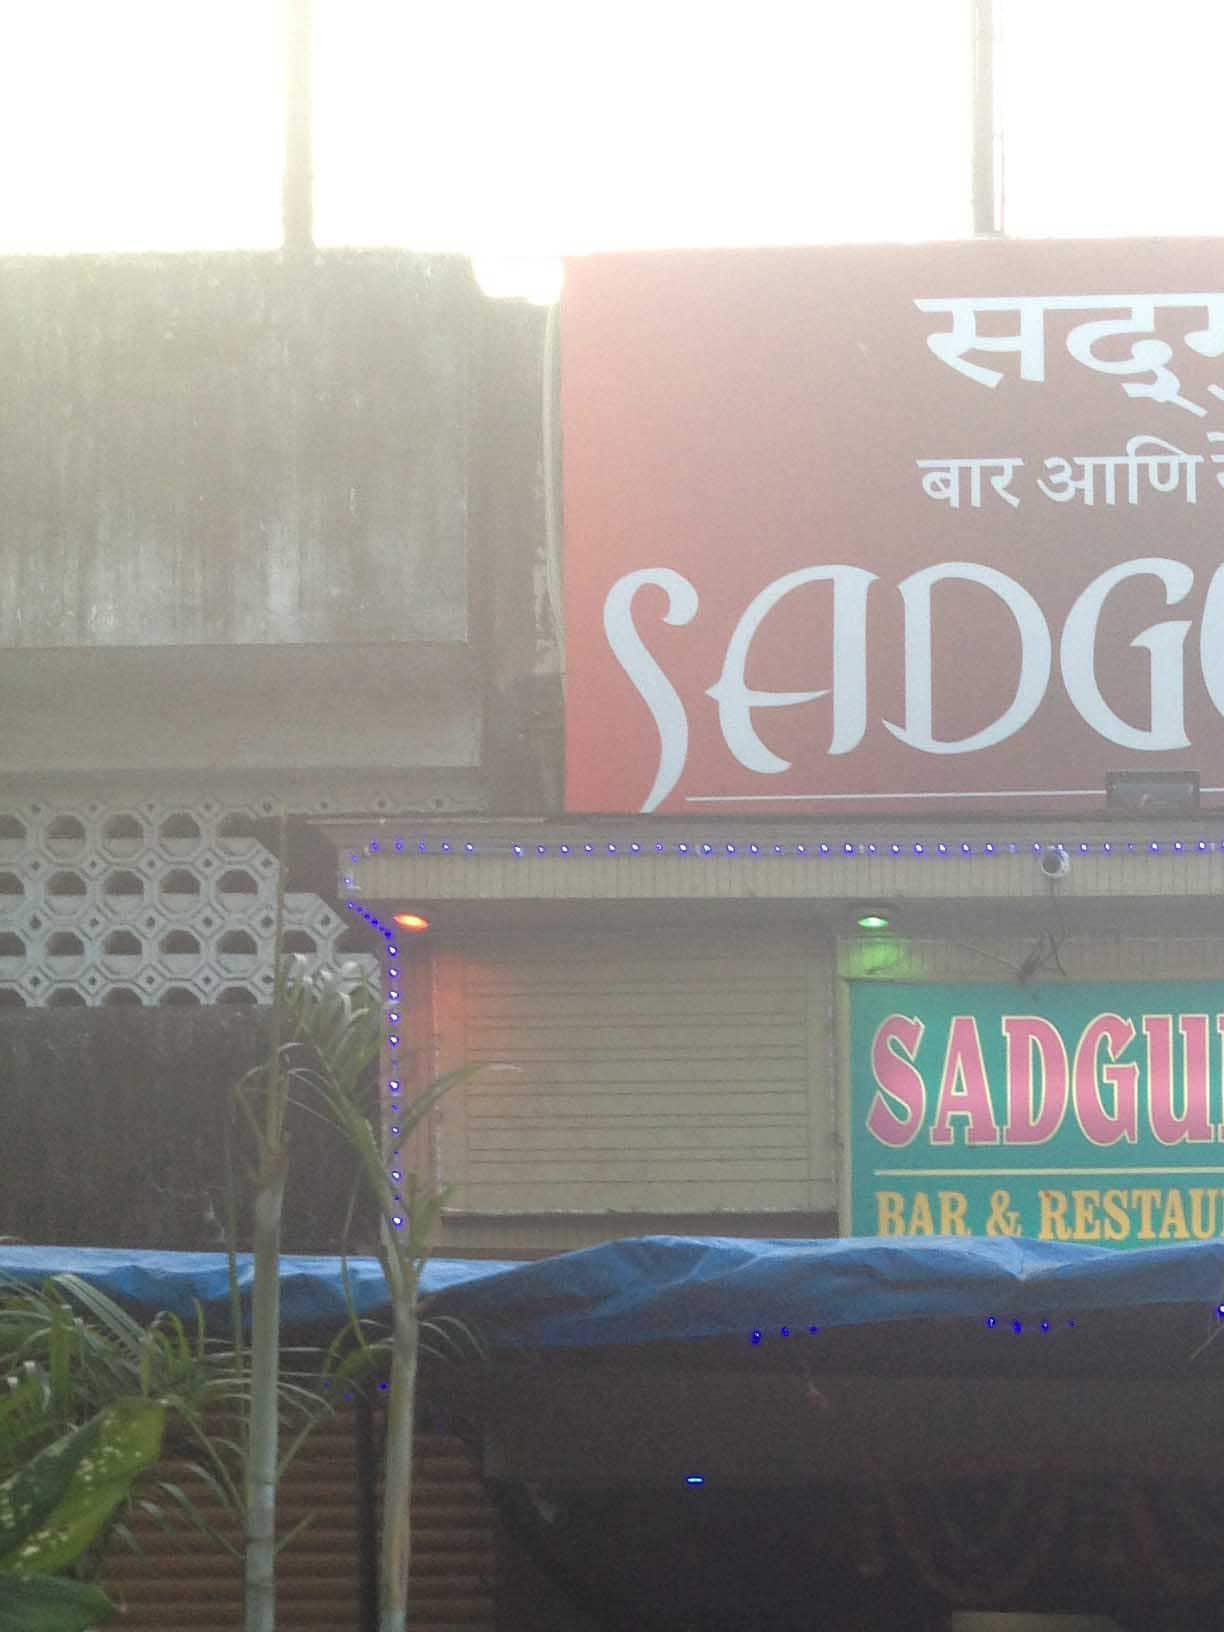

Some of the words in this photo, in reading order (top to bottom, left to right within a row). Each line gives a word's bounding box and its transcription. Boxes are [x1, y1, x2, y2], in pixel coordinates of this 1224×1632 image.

[915, 456, 1025, 509] बार
[1036, 434, 1205, 507] आणि
[874, 1190, 972, 1238] BAR
[985, 1189, 1023, 1238] &
